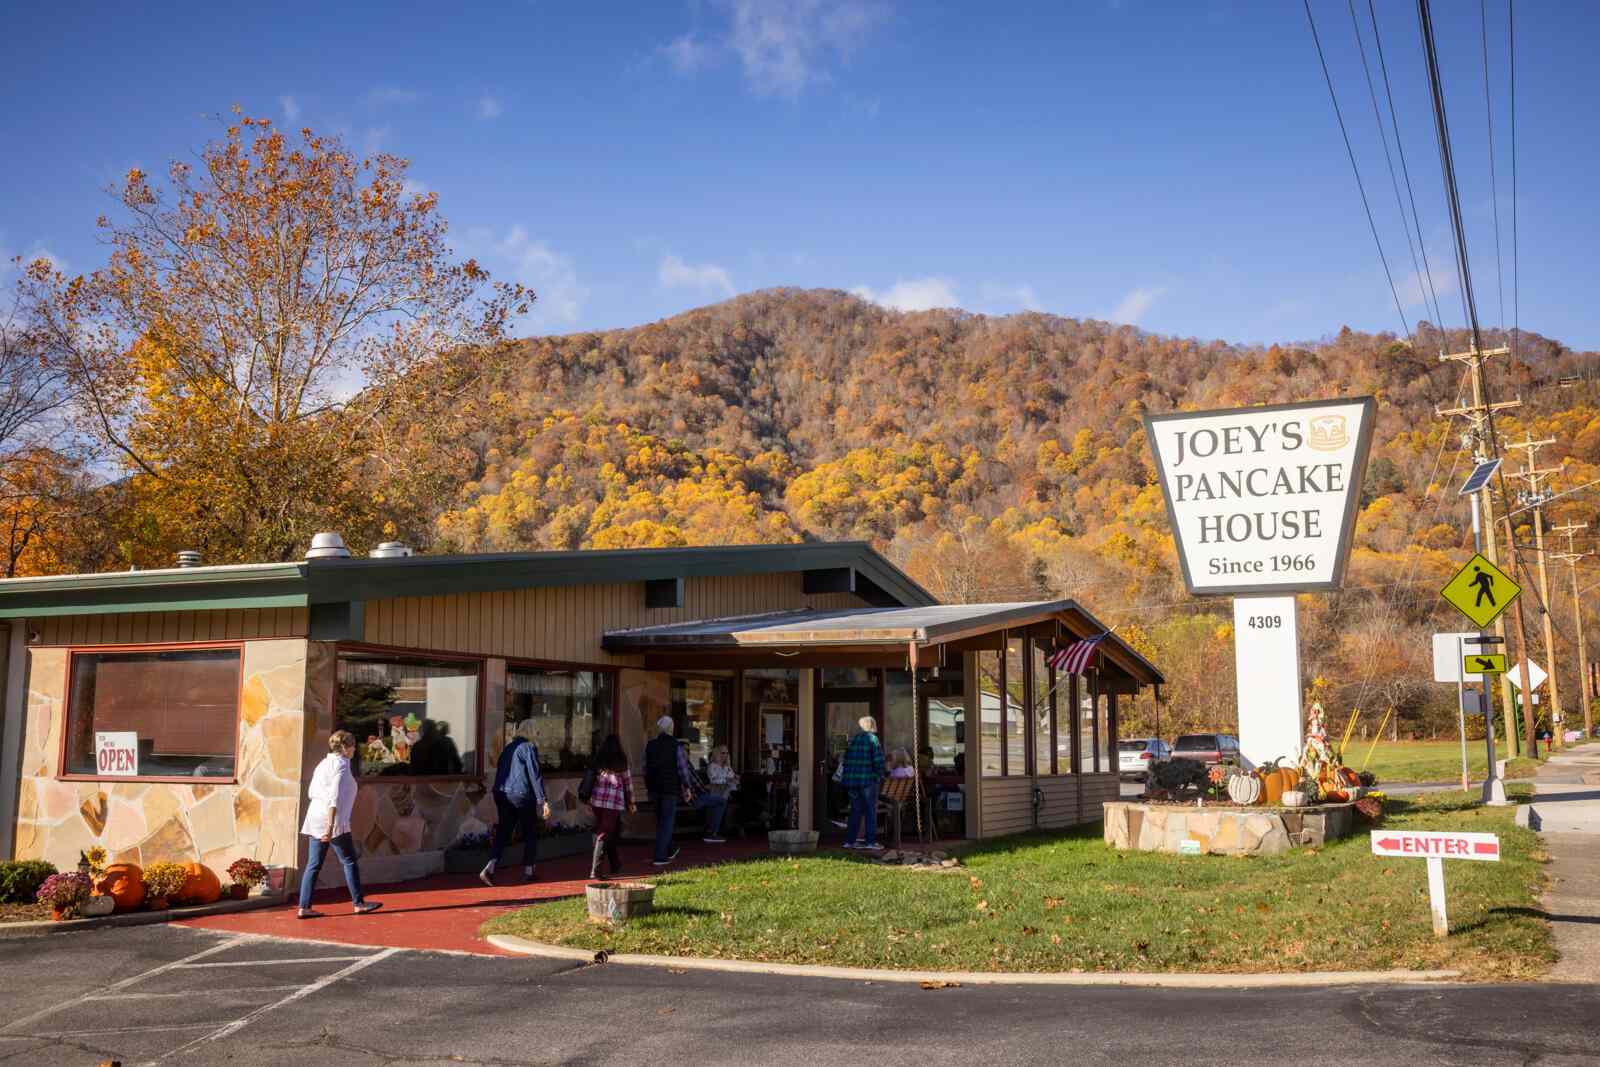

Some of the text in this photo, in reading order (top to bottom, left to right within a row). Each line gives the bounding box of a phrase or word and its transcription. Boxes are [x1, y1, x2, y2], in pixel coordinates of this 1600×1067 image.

[1174, 421, 1303, 467] JOEY'S
[1175, 463, 1344, 502] PANCAKE
[1198, 509, 1322, 544] HOUSE
[1209, 554, 1316, 575] Since 1966
[1248, 615, 1282, 629] 4309
[99, 748, 135, 771] OPEN
[1402, 837, 1470, 855] ENTER
